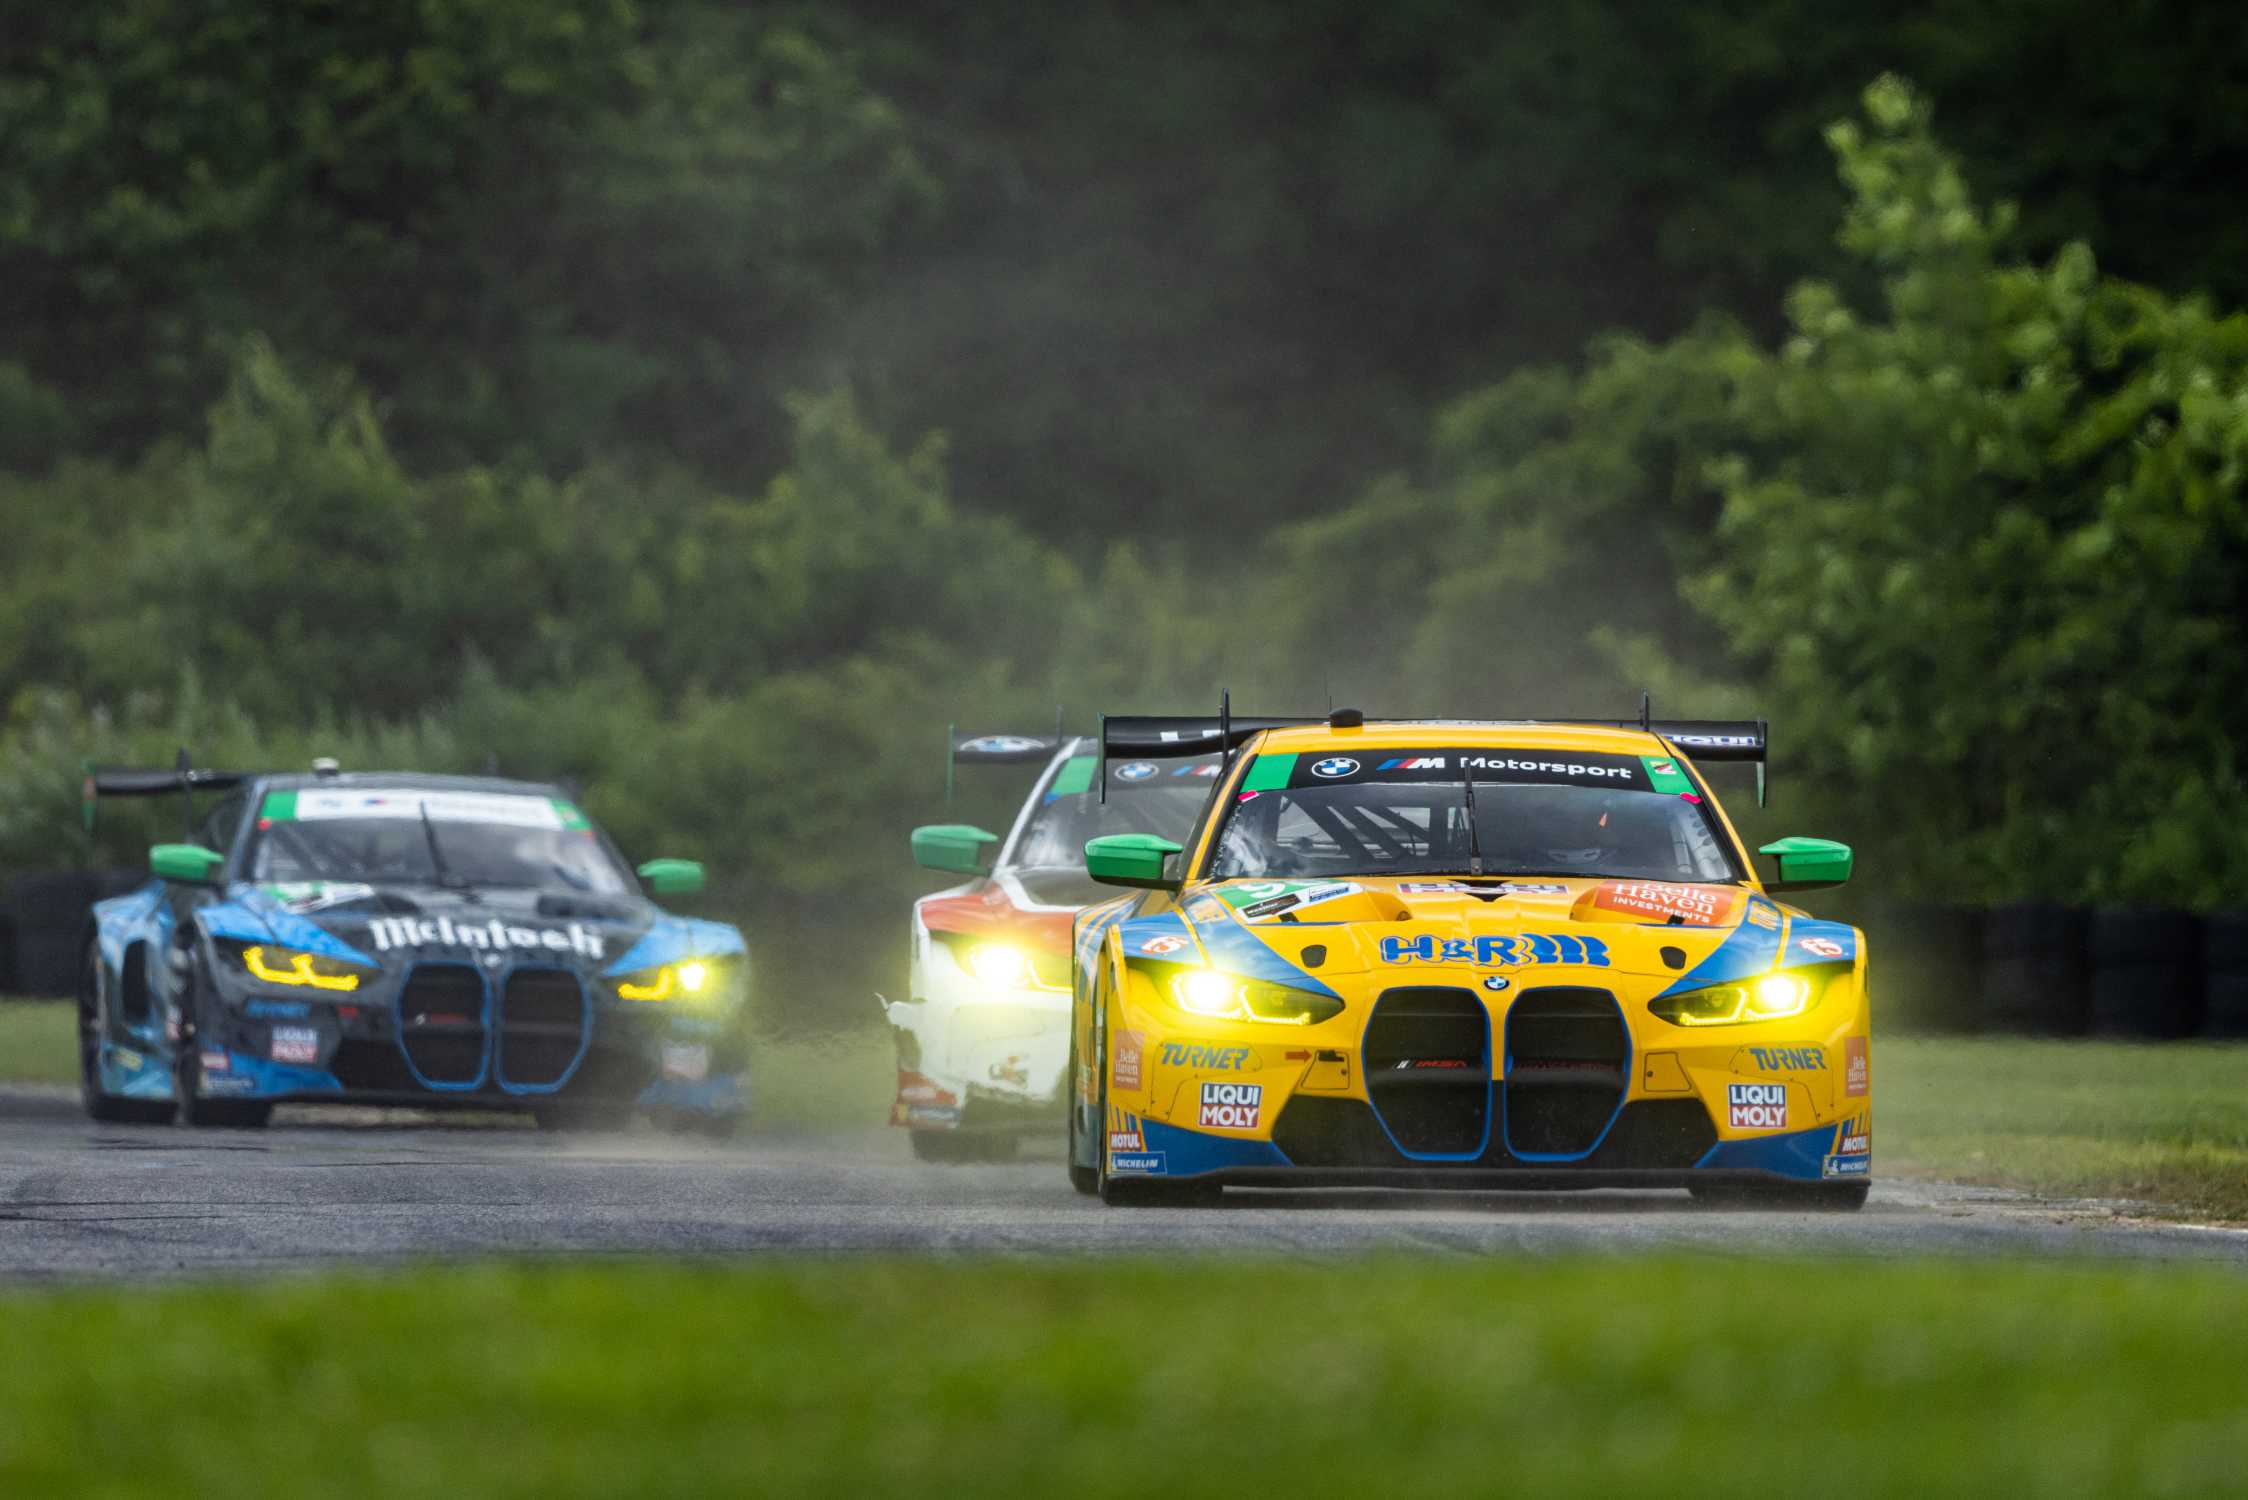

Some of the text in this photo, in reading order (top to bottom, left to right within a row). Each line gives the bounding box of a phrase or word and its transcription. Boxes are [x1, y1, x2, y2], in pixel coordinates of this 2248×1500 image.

[1460, 757, 1632, 779] Motorsport
[1612, 884, 1713, 914] Haven
[1641, 882, 1717, 903] Belle
[1613, 896, 1711, 923] INVESTMENTS
[368, 915, 604, 959] McIntosh
[1162, 1042, 1249, 1070] TURNER
[1749, 1047, 1827, 1070] TURNER
[1203, 1084, 1259, 1105] LIQUI
[1731, 1085, 1783, 1105] LIQUI
[1201, 1105, 1258, 1127] MOLY
[1733, 1106, 1785, 1127] MOLY
[1111, 1133, 1140, 1148] MOTUL
[1117, 1158, 1158, 1169] MICHELIN
